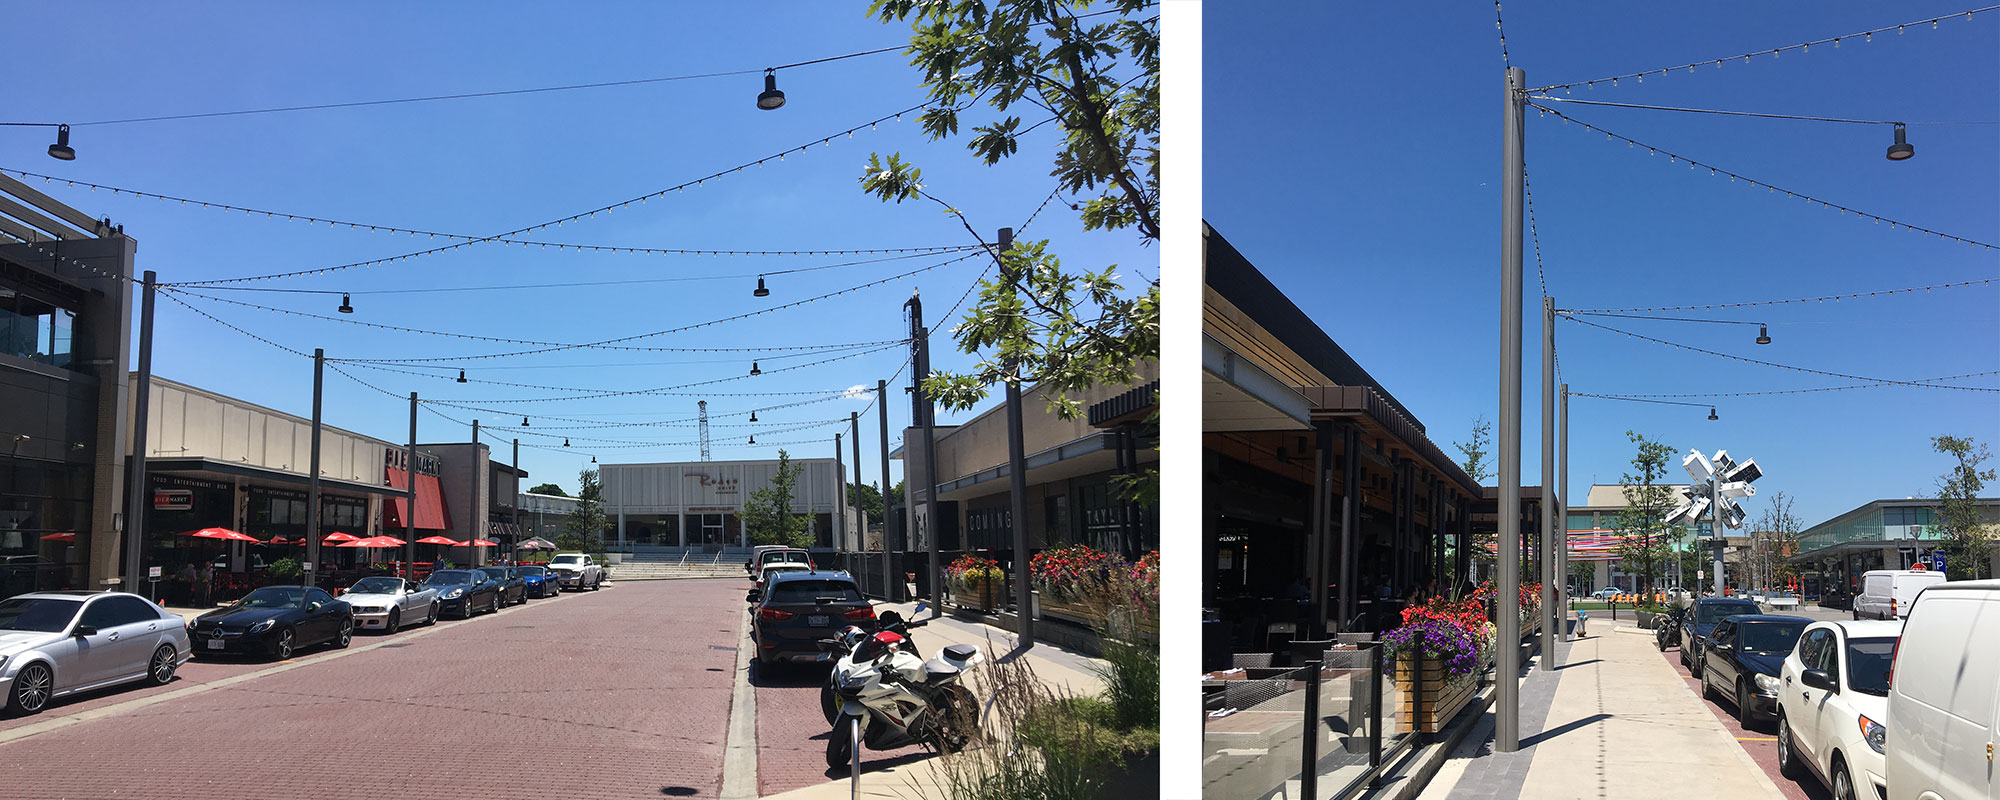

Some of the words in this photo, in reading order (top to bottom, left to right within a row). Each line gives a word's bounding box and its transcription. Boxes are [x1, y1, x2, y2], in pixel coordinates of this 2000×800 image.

[173, 478, 212, 488] ENTERTAINMENT
[684, 472, 738, 487] Rodeo
[969, 510, 1012, 531] COMING
[1936, 561, 1943, 570] P
